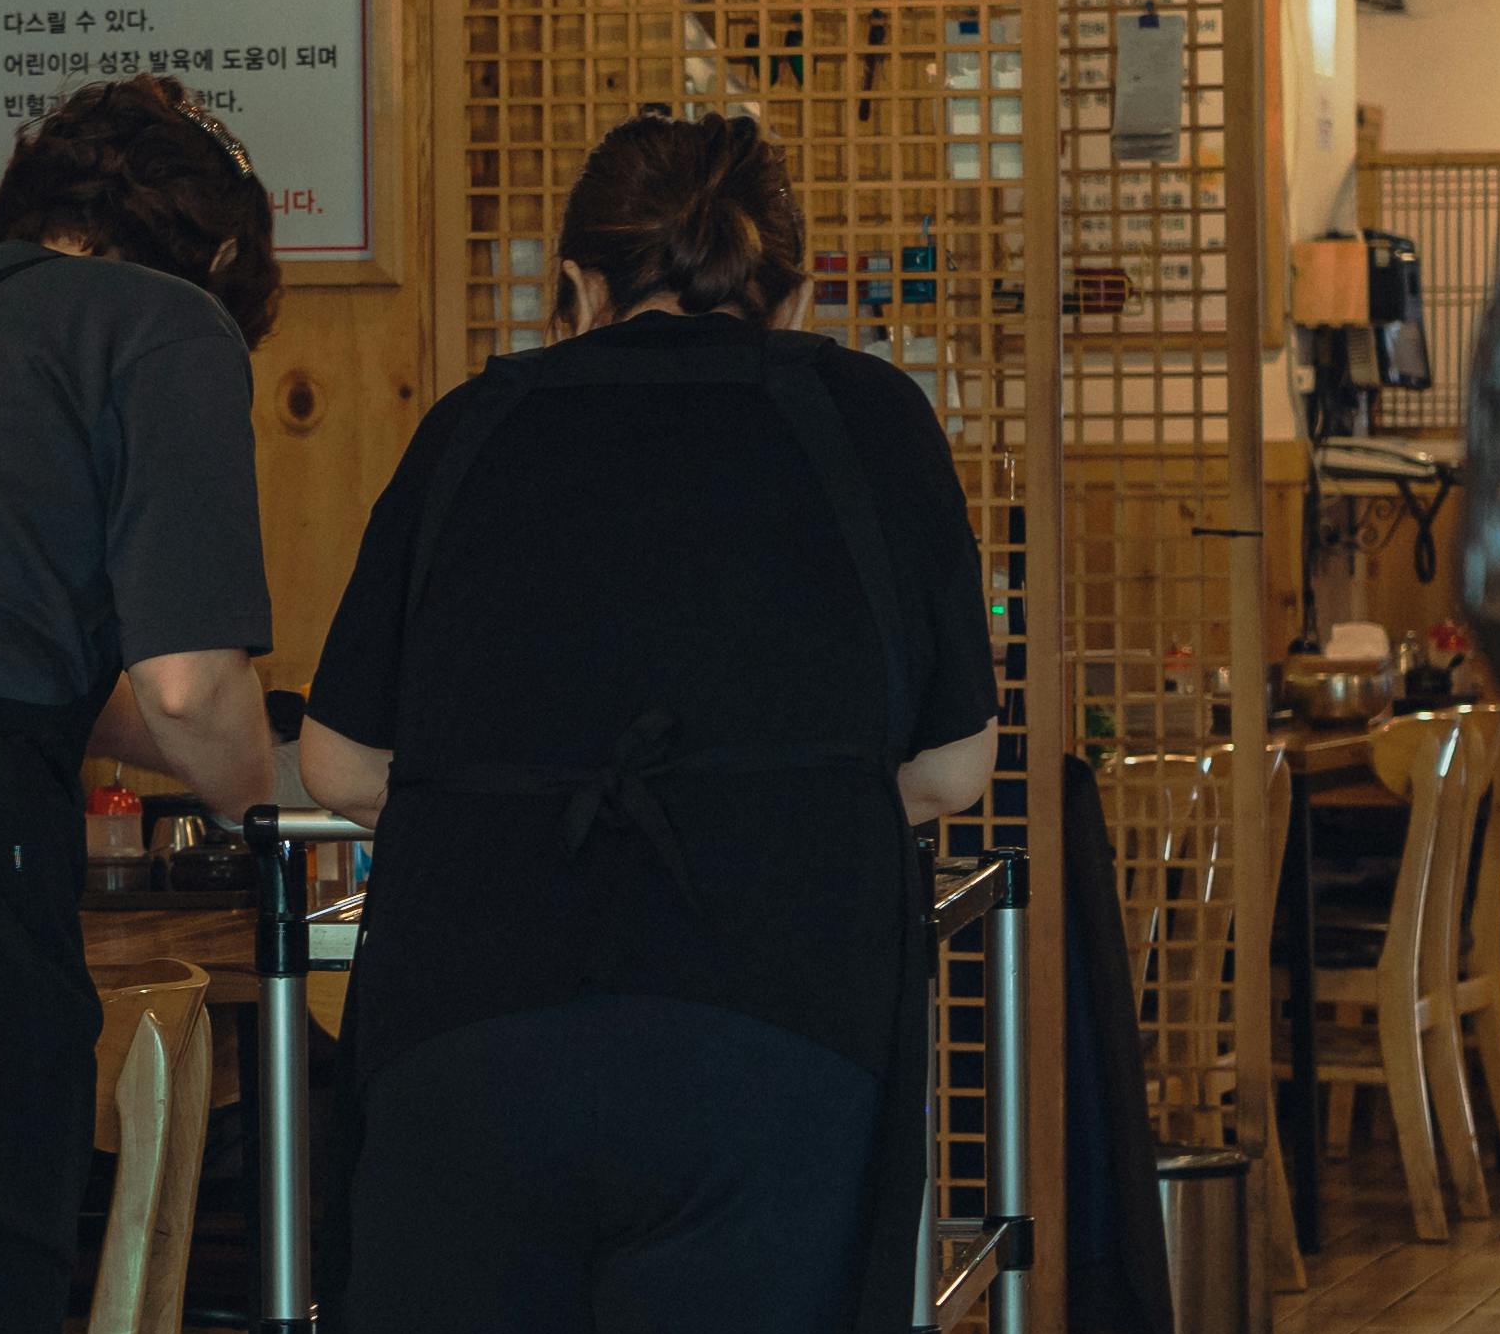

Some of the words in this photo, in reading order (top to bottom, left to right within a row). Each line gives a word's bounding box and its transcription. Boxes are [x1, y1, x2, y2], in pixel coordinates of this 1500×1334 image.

[3, 11, 67, 35] 다스릴
[75, 11, 96, 33] 수
[104, 8, 155, 32] 있다.
[4, 52, 89, 77] 어린이의
[99, 50, 140, 75] 성장
[149, 48, 214, 72] 발육에
[222, 46, 287, 70] 도움이
[296, 45, 337, 69] 되며
